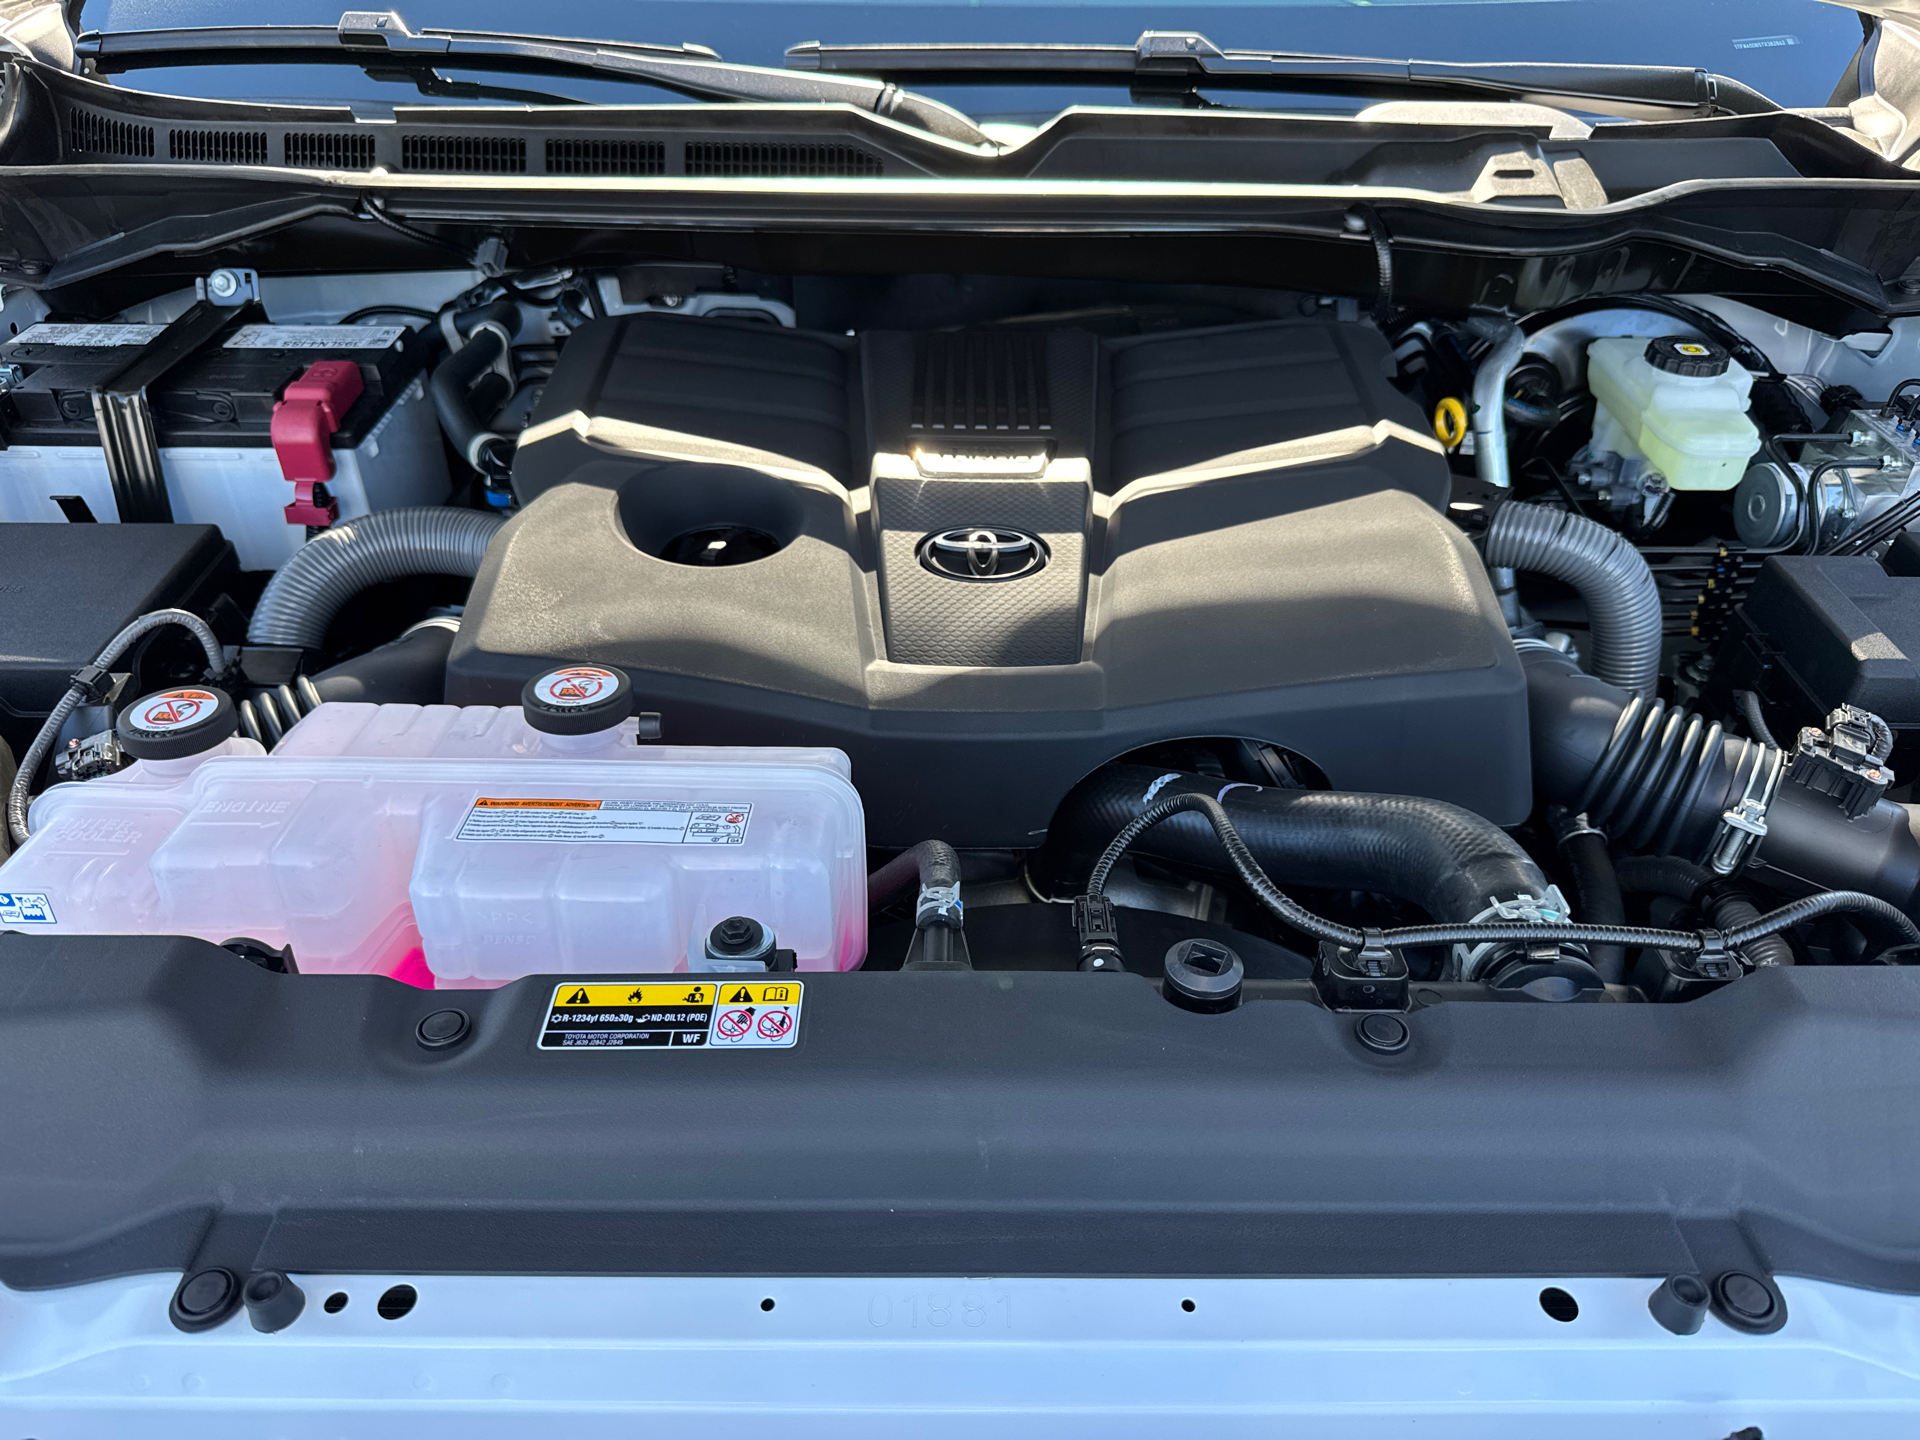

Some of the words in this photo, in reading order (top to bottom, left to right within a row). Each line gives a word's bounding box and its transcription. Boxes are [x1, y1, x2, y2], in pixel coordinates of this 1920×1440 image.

[200, 800, 290, 814] ENGINE
[61, 818, 135, 831] INTER
[53, 830, 143, 844] COOLER
[562, 1013, 599, 1024] R-1234yf
[599, 1013, 634, 1024] 650±30g
[651, 1013, 686, 1022] ND-OIL12
[687, 1013, 708, 1023] (POE)
[682, 1033, 701, 1044] WF
[868, 1291, 1012, 1329] 01881
